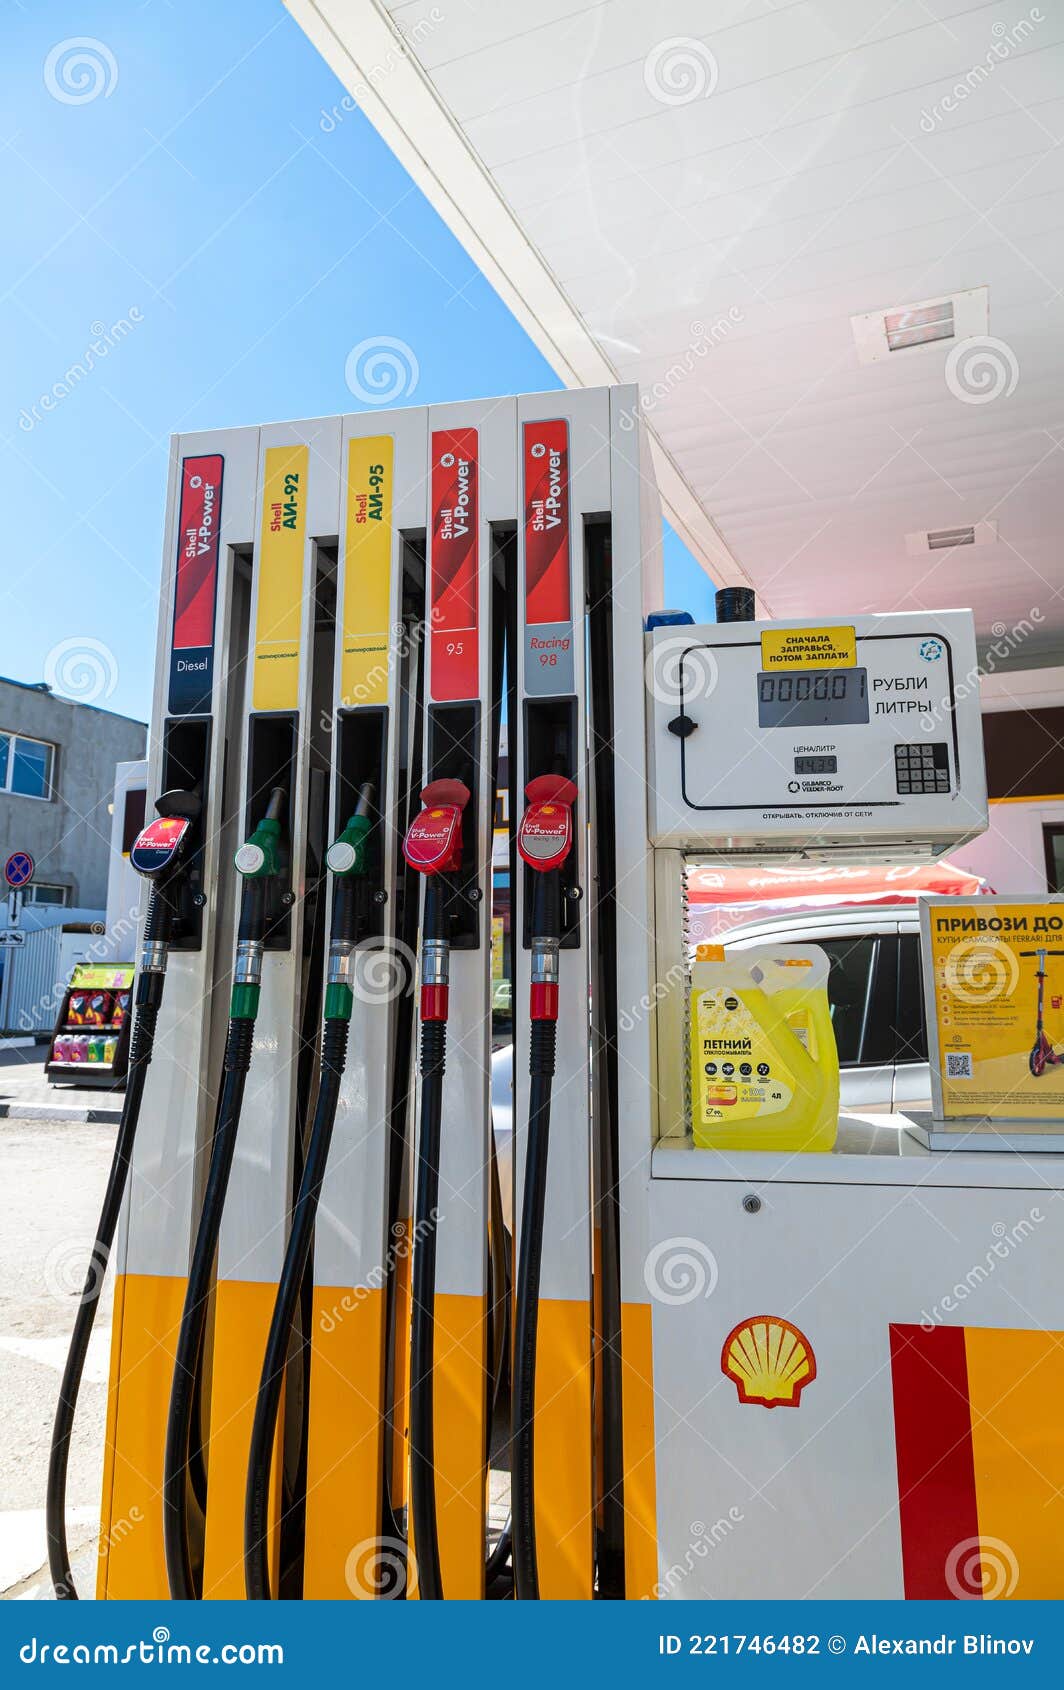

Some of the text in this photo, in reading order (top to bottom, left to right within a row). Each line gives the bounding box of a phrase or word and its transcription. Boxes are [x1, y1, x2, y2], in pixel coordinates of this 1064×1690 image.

[368, 464, 384, 520] АИ-95
[545, 449, 561, 530] V-Power
[283, 473, 299, 529] АИ-92
[454, 458, 469, 538] V-Power
[356, 494, 367, 524] Shell
[532, 500, 544, 531] Shell
[198, 484, 214, 555] V-Power
[271, 503, 282, 532] Shell
[441, 509, 452, 540] Shell
[186, 529, 197, 557] Shell
[530, 637, 570, 651] Racing
[786, 635, 830, 644] СНАЧАЛА
[446, 642, 464, 656] 95
[781, 644, 836, 653] ЗАПРАВЬСЯ,
[539, 654, 557, 667] 98
[769, 651, 848, 663] ПОТОМ ЗАПЛАТИ
[177, 658, 208, 672] Diesel
[873, 677, 928, 691] РУБЛИ
[875, 700, 932, 714] ЛИТРЫ
[793, 745, 836, 754] ЦЕНА/ЛИТР
[936, 916, 1063, 932] ПРИВОЗИ ДО
[937, 936, 960, 944] КУПИ
[1012, 934, 1043, 943] FERRARI
[1045, 934, 1063, 942] ДЛЯ
[704, 1037, 752, 1049] ЛЕТНИЙ
